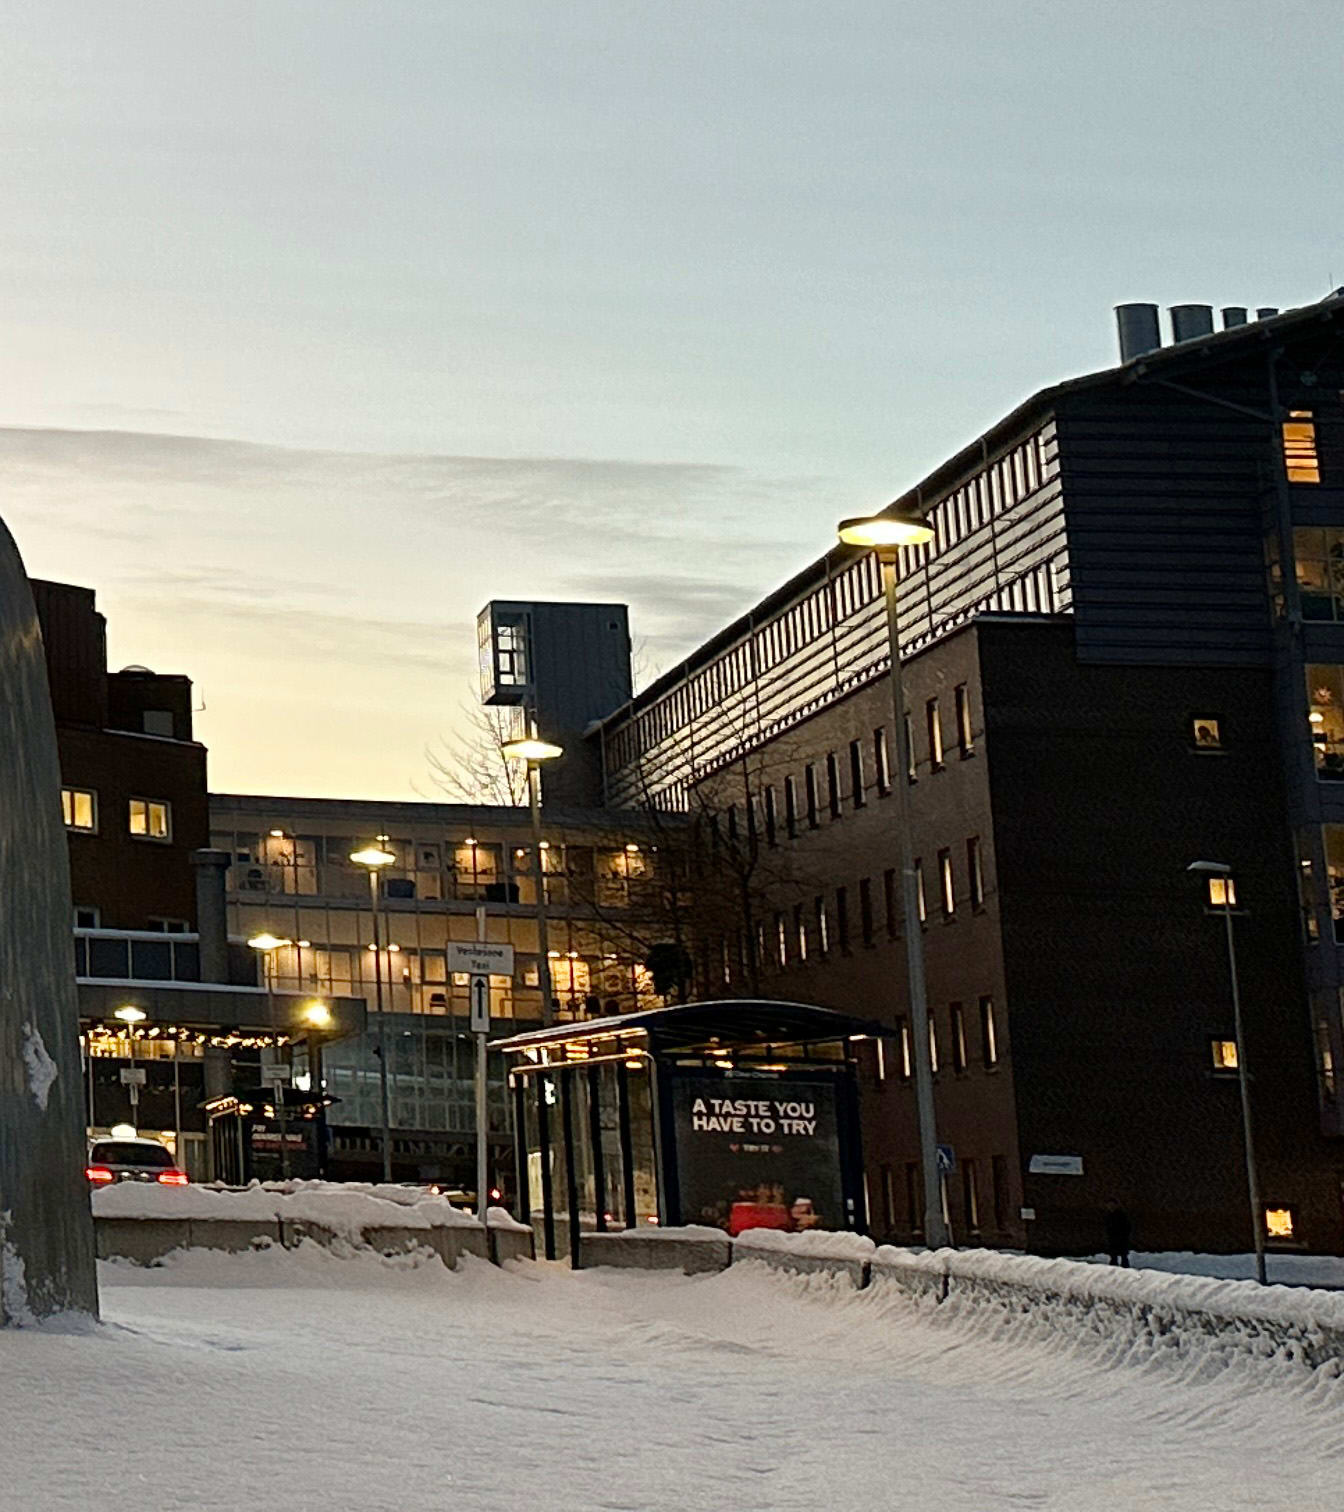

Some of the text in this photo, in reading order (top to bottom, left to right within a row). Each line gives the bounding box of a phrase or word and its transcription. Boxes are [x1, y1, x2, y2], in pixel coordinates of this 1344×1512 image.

[692, 1098, 815, 1118] A TASTE YOU
[692, 1115, 817, 1136] HAVE TO TRY
